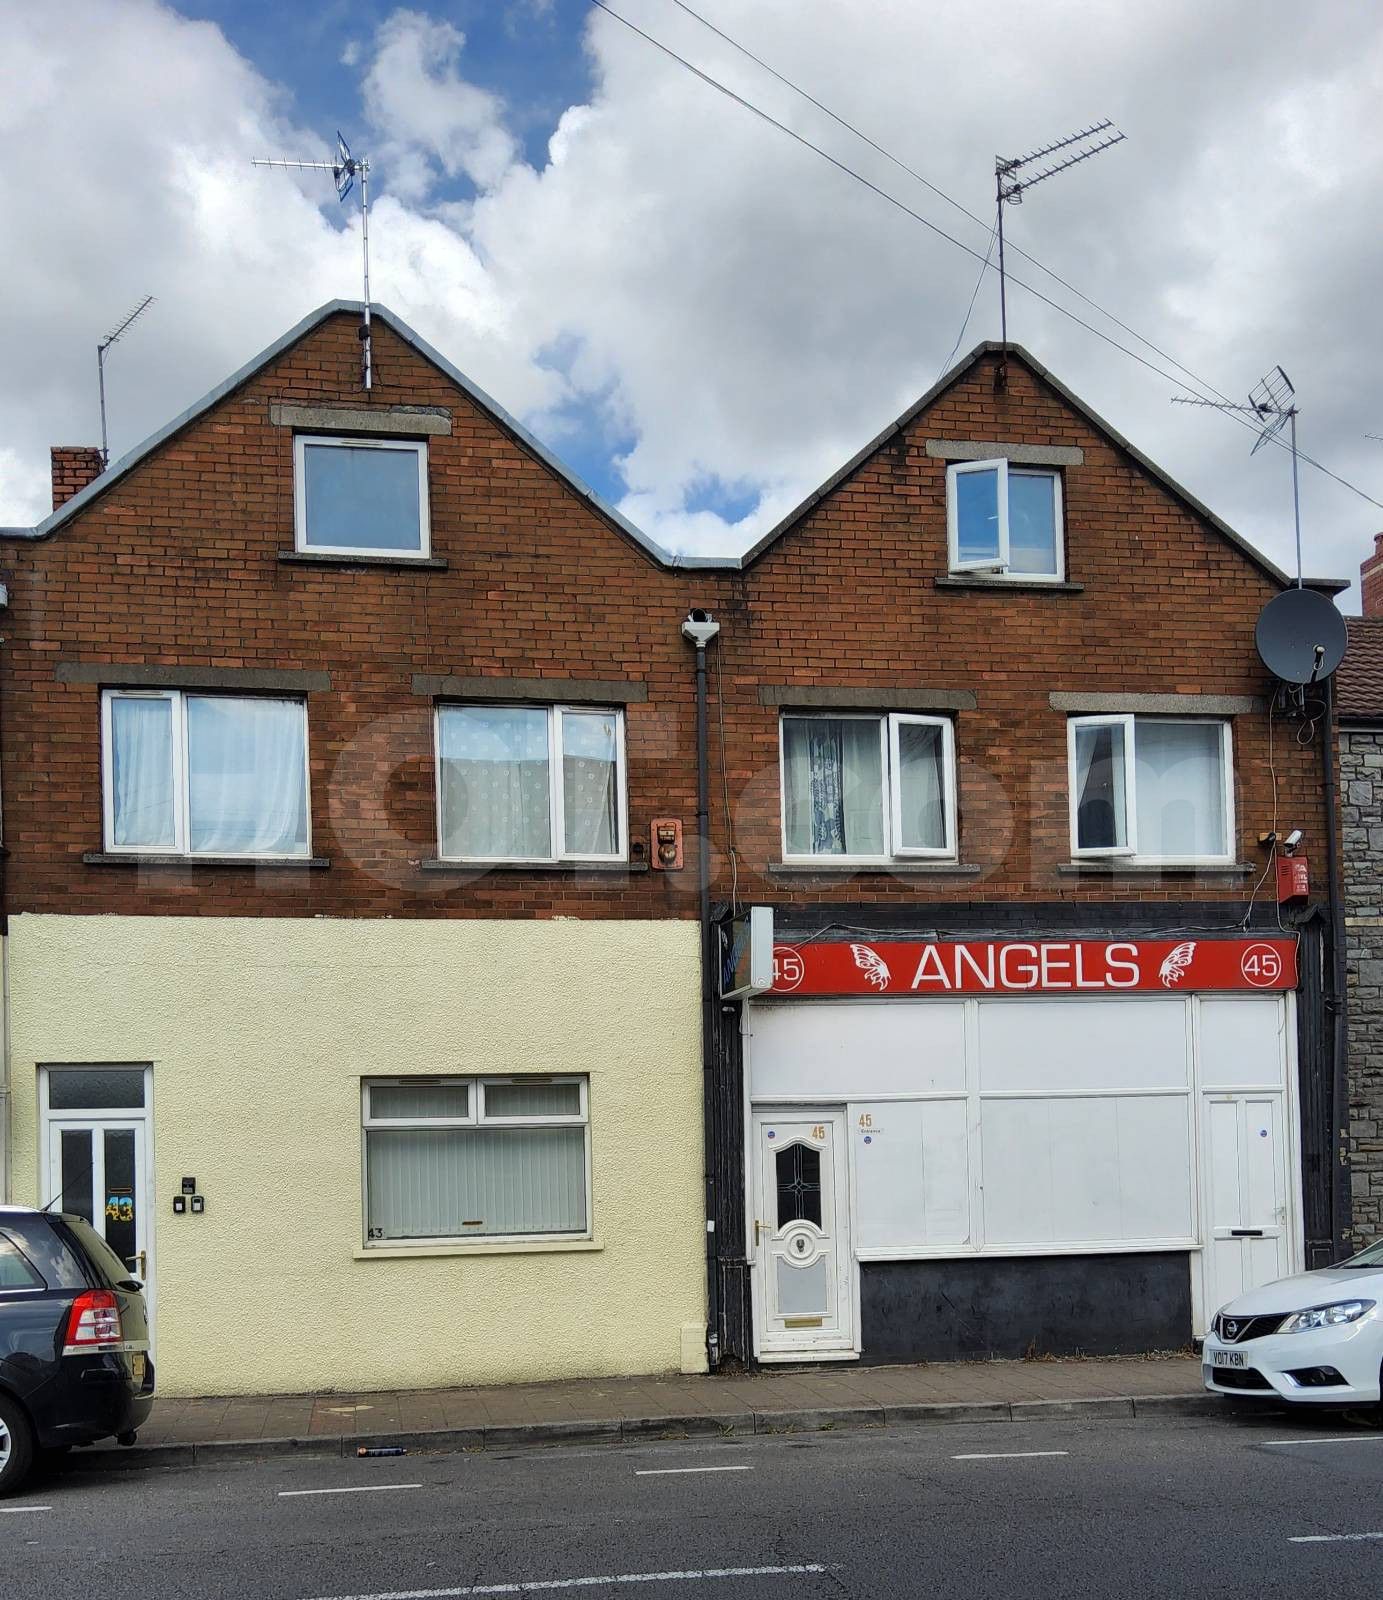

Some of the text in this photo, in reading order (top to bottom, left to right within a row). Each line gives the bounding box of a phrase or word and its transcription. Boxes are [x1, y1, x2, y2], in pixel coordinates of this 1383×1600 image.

[910, 942, 1140, 990] ANGELS
[1244, 954, 1277, 977] 45
[859, 1113, 872, 1127] 45
[812, 1126, 825, 1139] 45
[105, 1196, 133, 1221] 43
[368, 1227, 384, 1239] 43
